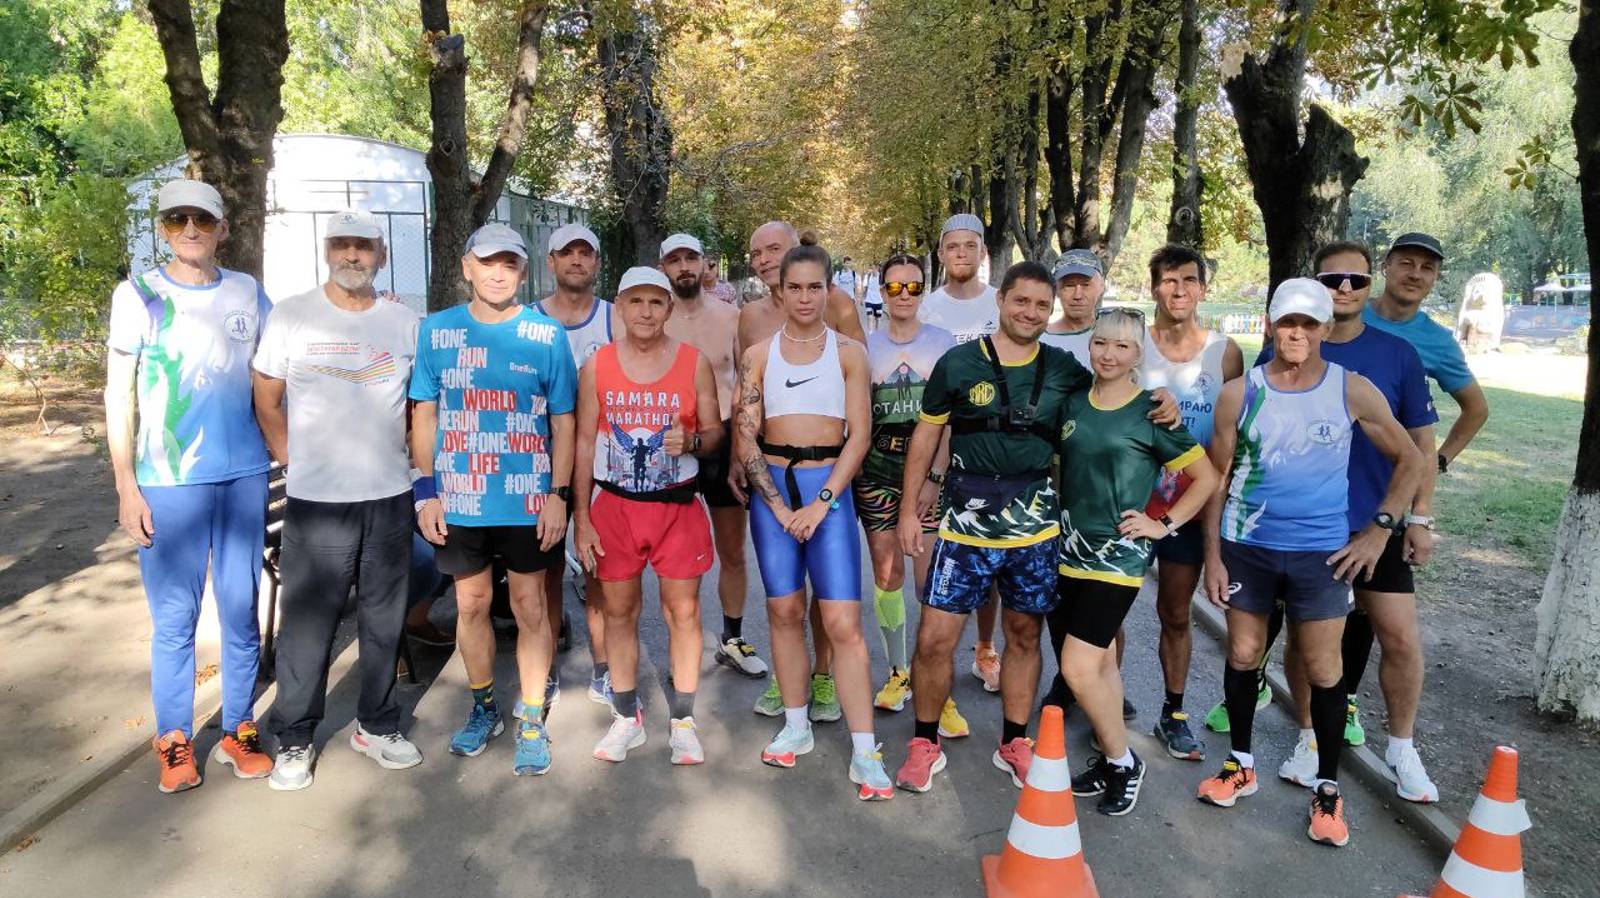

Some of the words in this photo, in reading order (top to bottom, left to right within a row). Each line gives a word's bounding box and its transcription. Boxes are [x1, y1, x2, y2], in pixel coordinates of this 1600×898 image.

[431, 328, 468, 350] #ONE
[517, 320, 557, 345] #ONE
[457, 347, 488, 368] RUN
[509, 362, 537, 374] OneRun
[441, 368, 475, 389] #ONE
[463, 389, 516, 411] WORLD
[606, 391, 680, 408] SAMARA
[506, 412, 538, 435] #ONE
[606, 412, 674, 426] MARATHO
[469, 453, 500, 475] LIFE
[441, 472, 487, 495] WORLD
[504, 473, 541, 495] #ONE
